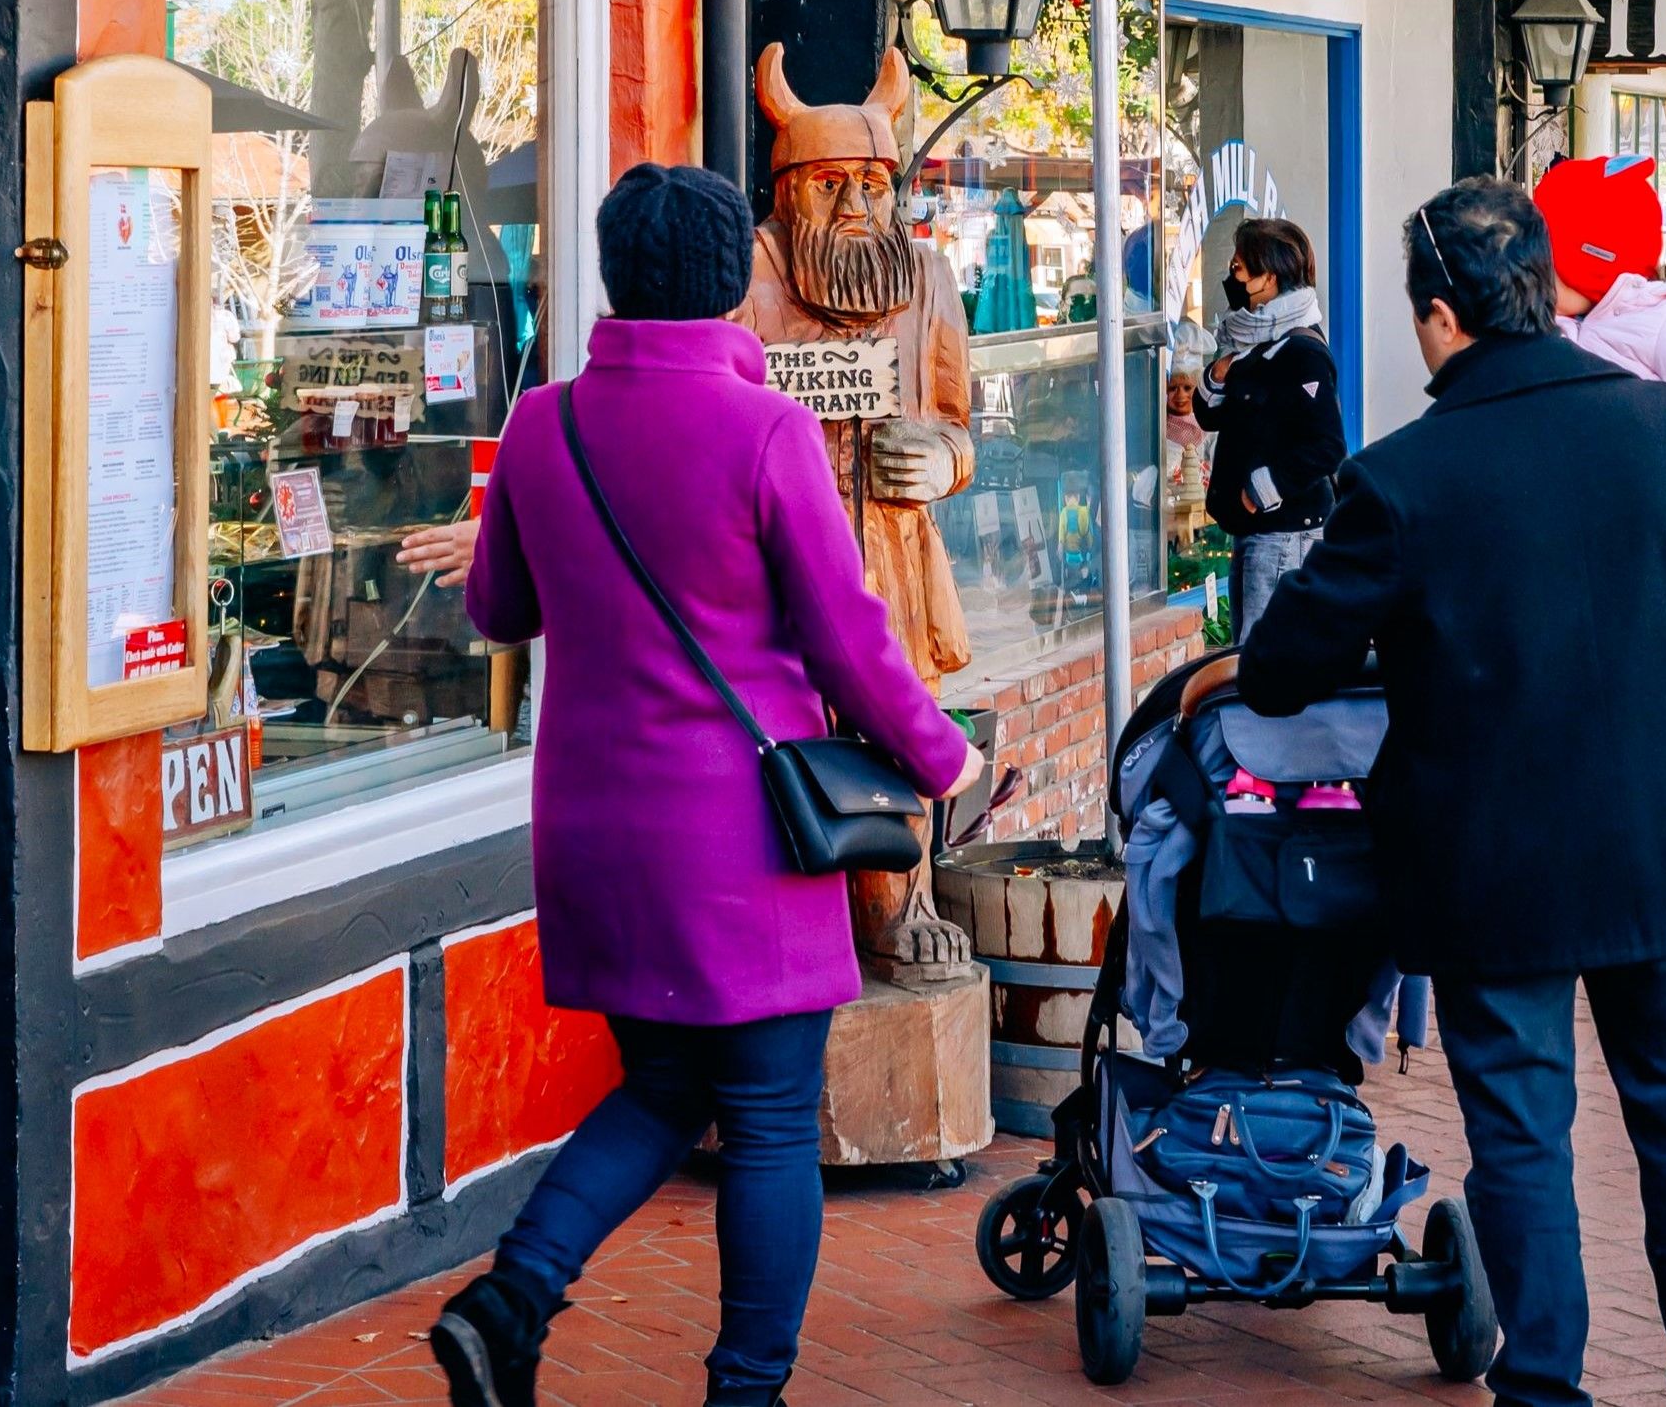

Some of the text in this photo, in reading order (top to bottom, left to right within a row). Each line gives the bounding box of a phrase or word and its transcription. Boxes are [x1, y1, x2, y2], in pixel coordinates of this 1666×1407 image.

[1212, 143, 1259, 213] MILL
[765, 351, 816, 370] THE
[773, 368, 873, 393] VIKING
[162, 735, 245, 831] PEN
